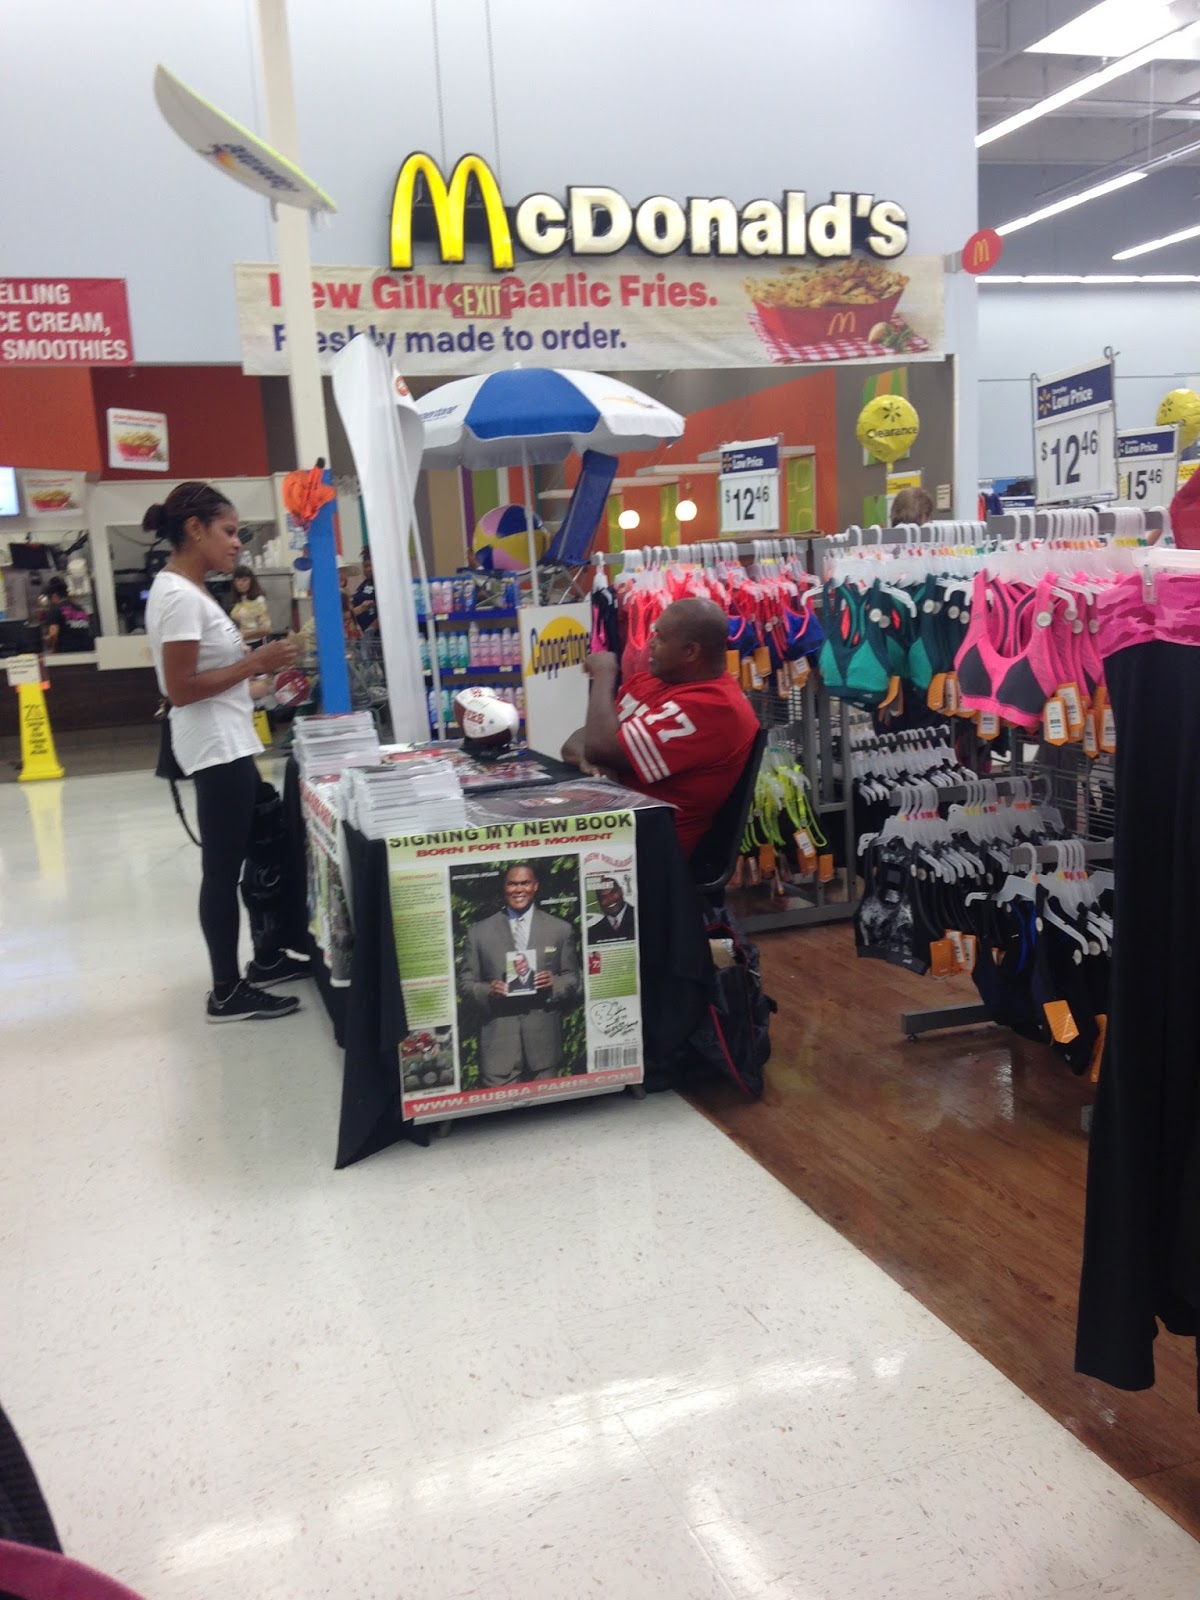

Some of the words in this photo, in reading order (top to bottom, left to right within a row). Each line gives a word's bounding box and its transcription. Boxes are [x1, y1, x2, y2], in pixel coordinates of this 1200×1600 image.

[388, 151, 909, 270] McDonald's
[462, 285, 502, 316] EXIT
[500, 272, 611, 308] Garlic
[619, 271, 718, 307] Fries.
[26, 311, 111, 337] CREAM,
[405, 325, 495, 353] made
[503, 327, 533, 351] to
[541, 321, 627, 349] order.
[2, 338, 128, 361] SMOOTHIES
[866, 426, 918, 439] Clearance
[388, 828, 479, 848] SIGNING
[486, 823, 517, 840] MY
[523, 818, 568, 836] NEW
[575, 813, 633, 831] BOOK
[416, 846, 465, 858] BORN
[468, 842, 502, 853] FOR
[504, 838, 540, 850] THIS
[544, 831, 614, 846] MOMENT
